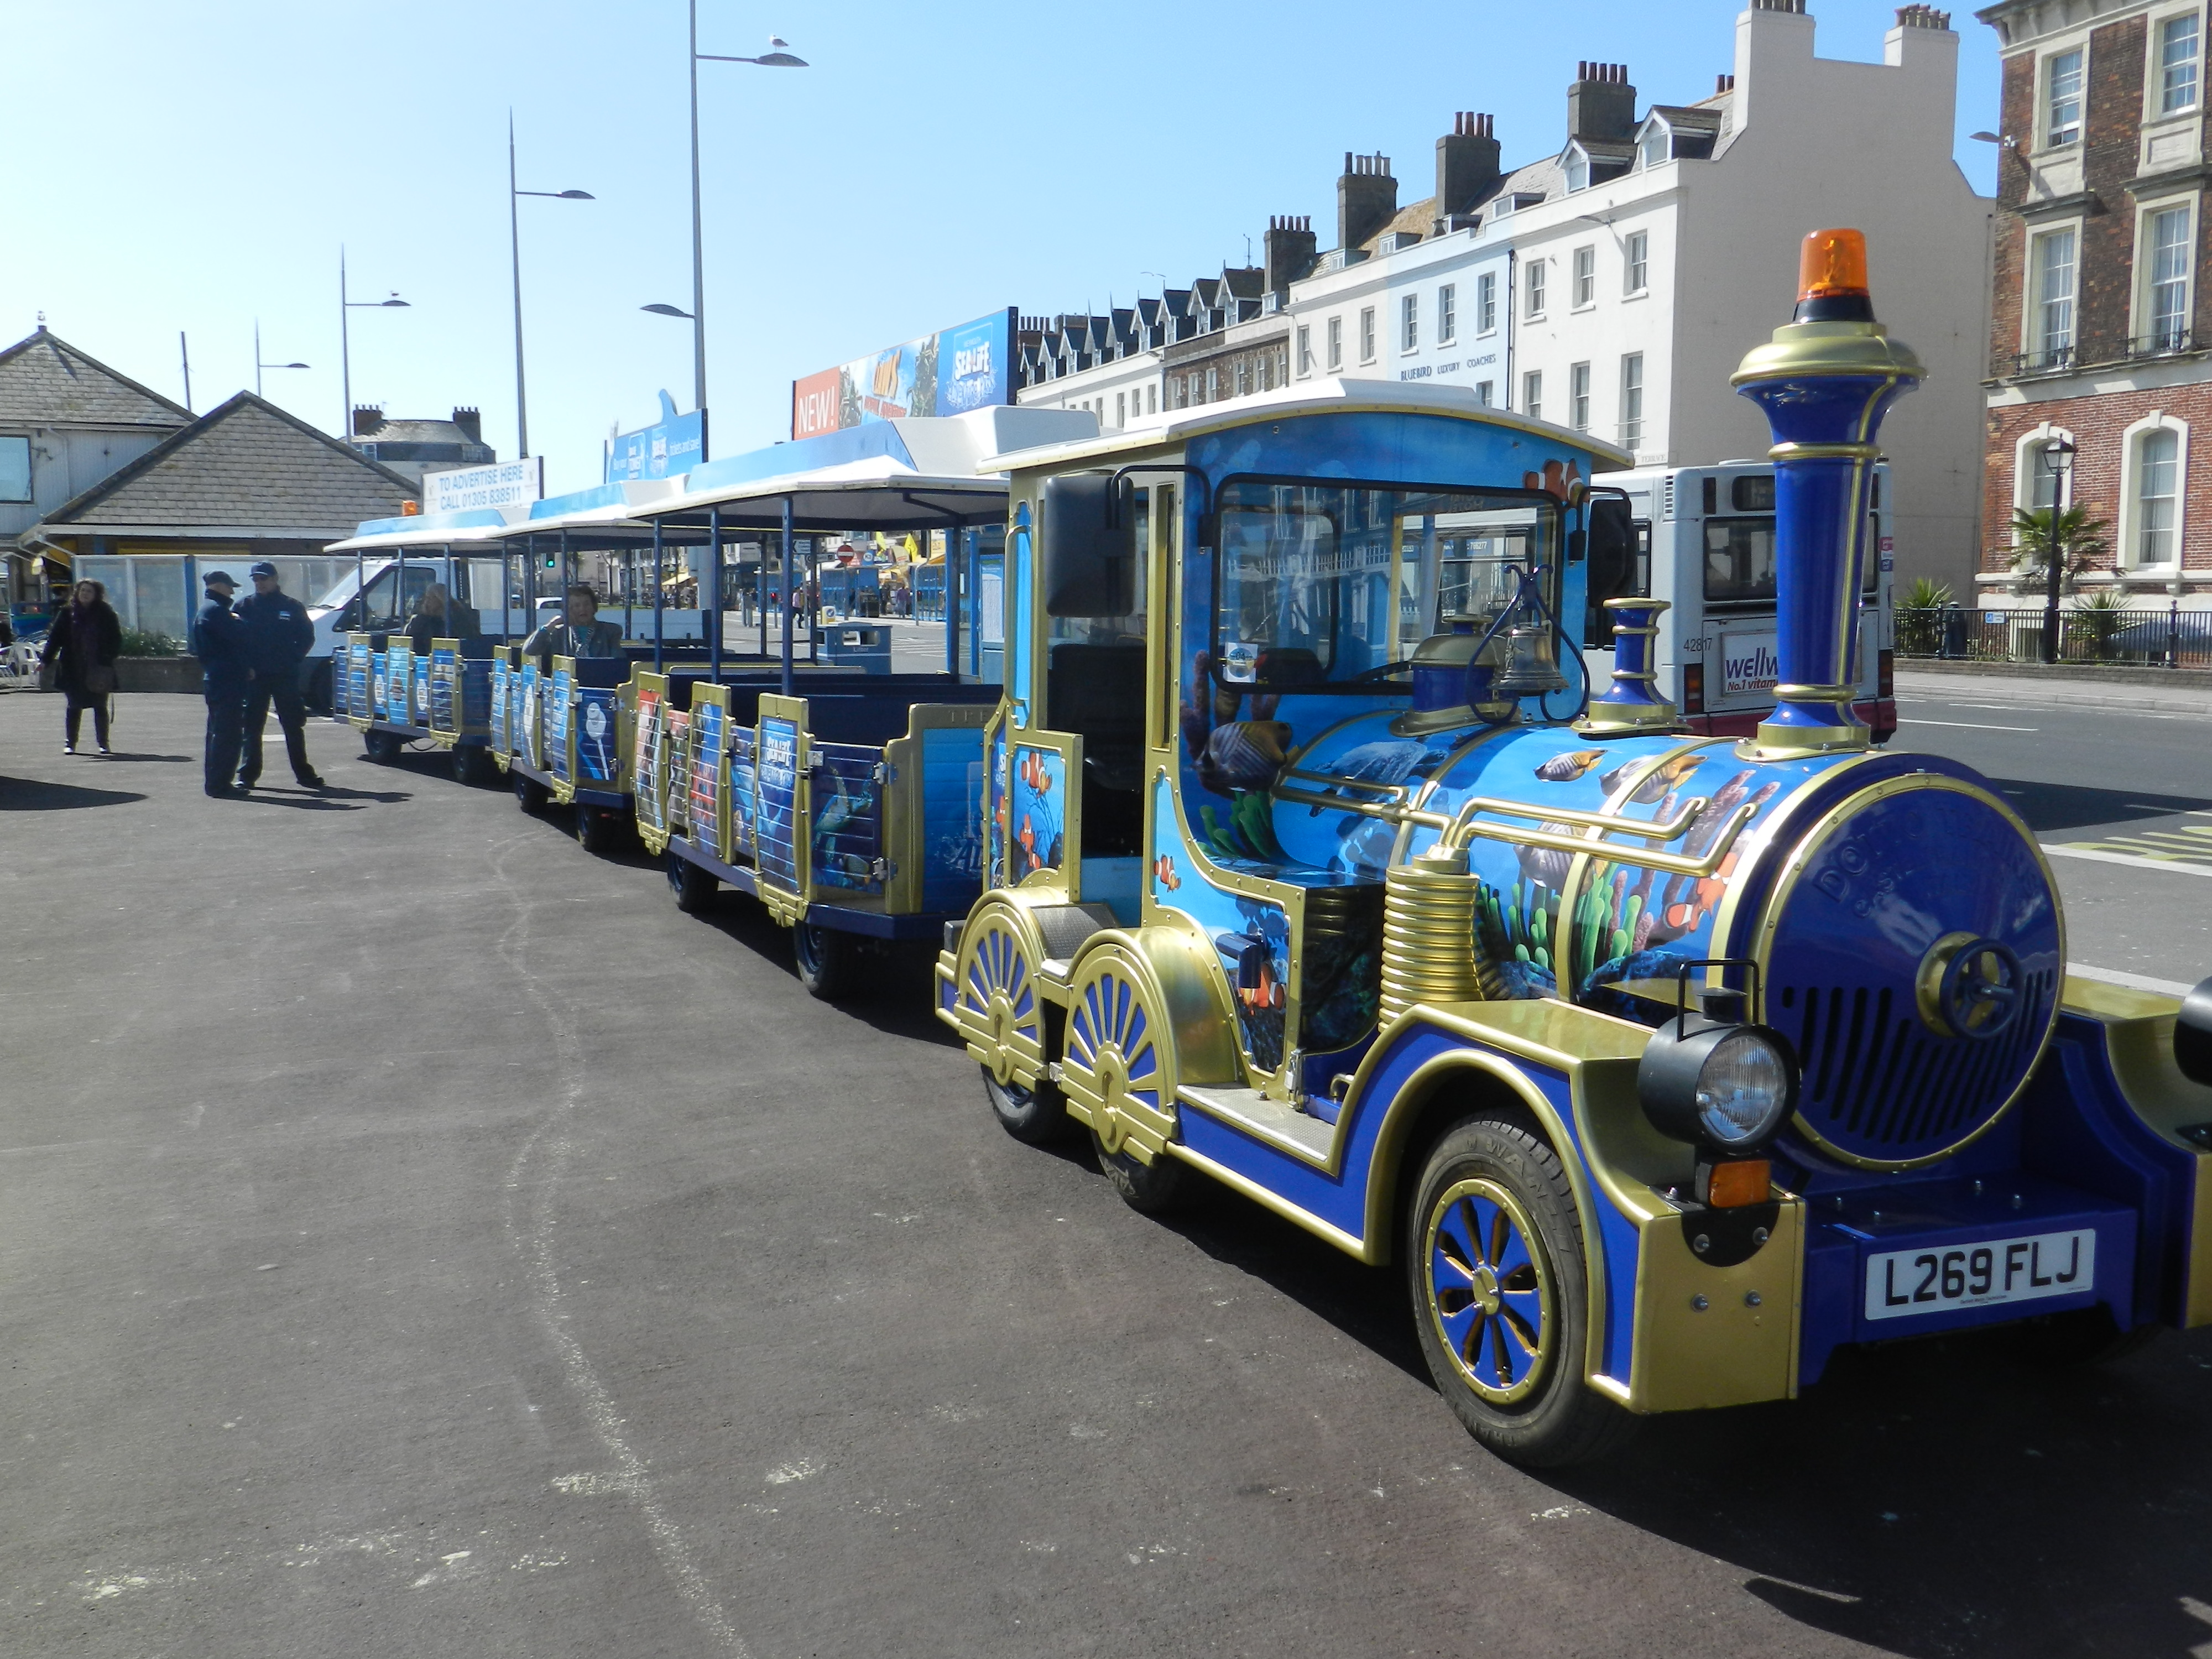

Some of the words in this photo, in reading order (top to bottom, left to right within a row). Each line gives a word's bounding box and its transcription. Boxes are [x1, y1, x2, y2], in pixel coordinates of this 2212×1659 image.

[954, 349, 972, 381] SEA
[972, 341, 990, 373] LIFE
[1401, 366, 1432, 382] BLUEBIRD
[1437, 362, 1460, 374] LUXURY
[1467, 353, 1496, 368] COACHES
[798, 385, 835, 435] NEW!
[439, 477, 450, 492] TO
[452, 469, 498, 490] ADVERTISE
[500, 465, 524, 483] HERE
[441, 494, 460, 510] CALL
[462, 491, 487, 506] 01305
[489, 486, 521, 504] 838511
[1683, 638, 1713, 652] 42817
[1728, 680, 1746, 691] No.1
[1885, 1248, 1992, 1307] L269
[2004, 1236, 2079, 1291] FLJ
